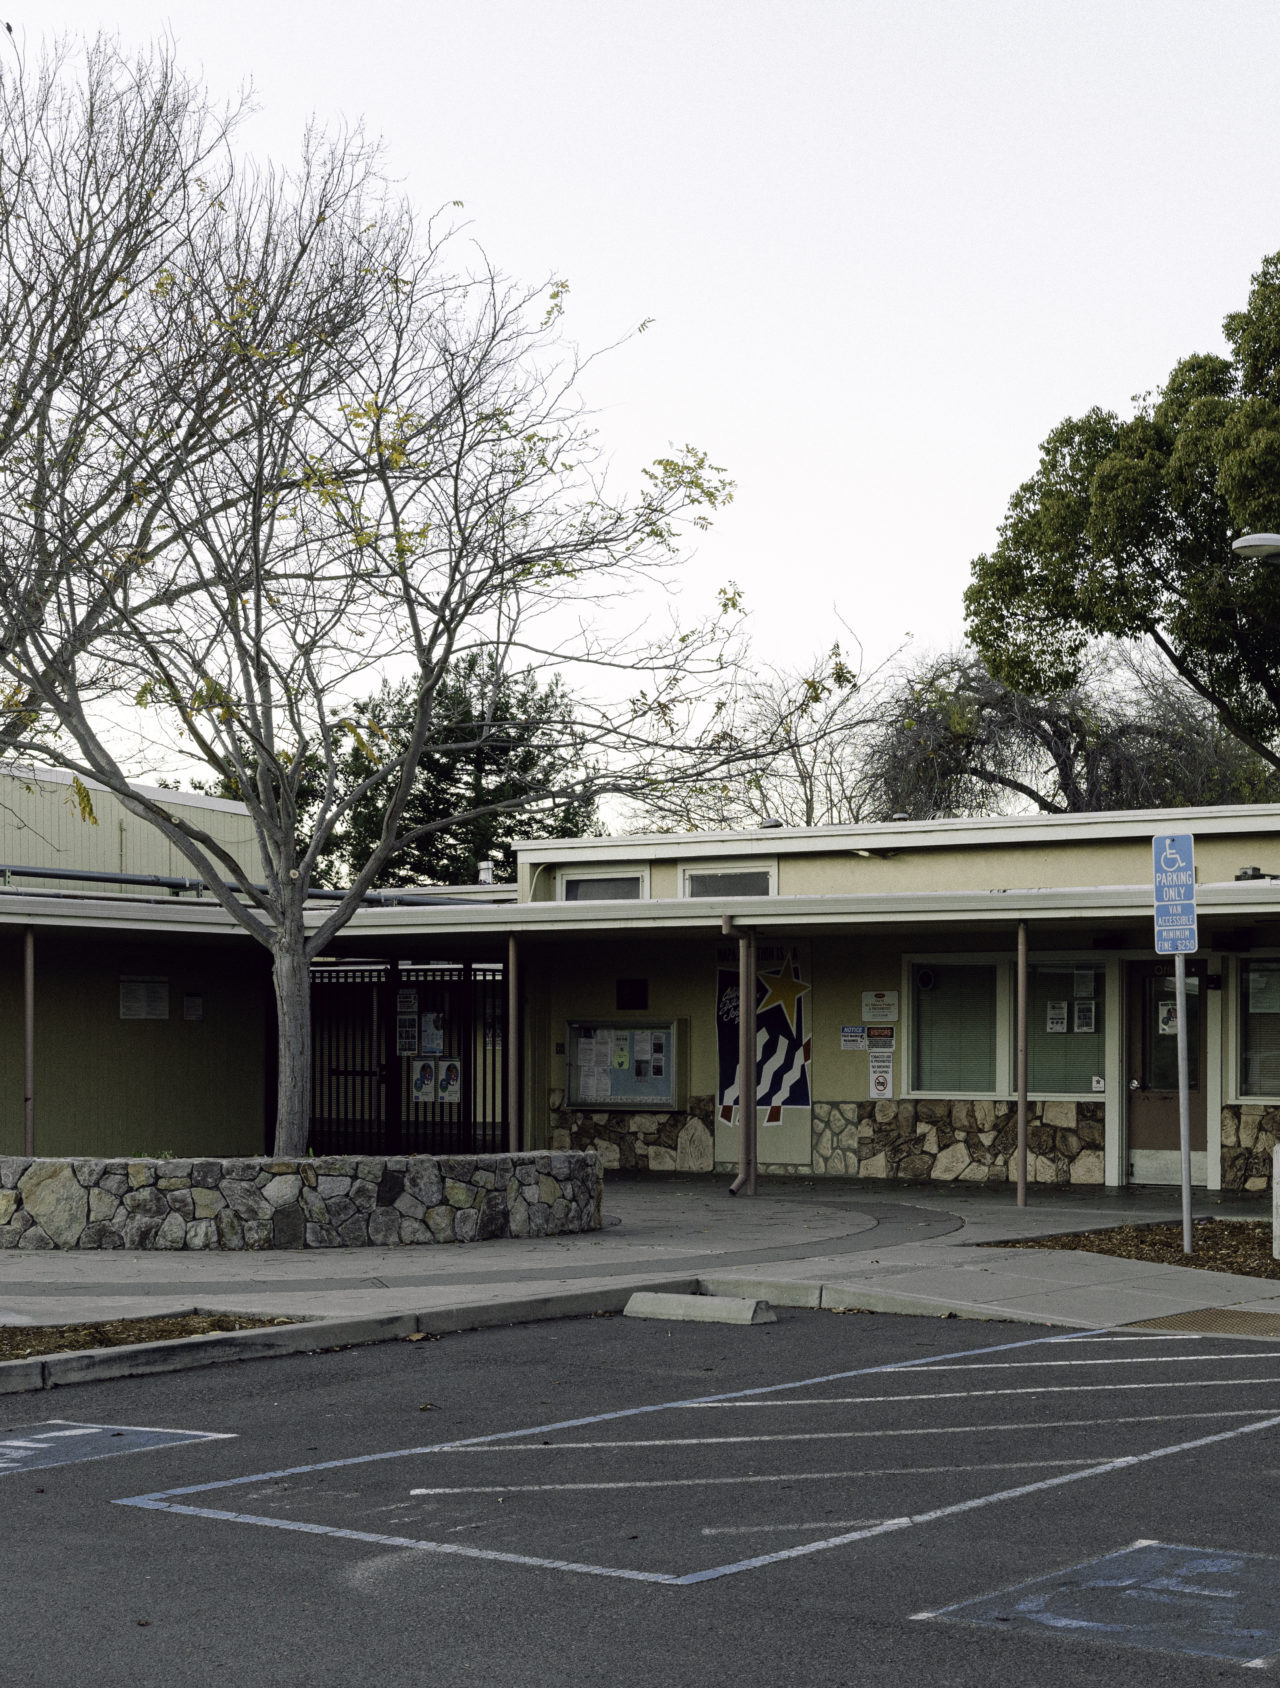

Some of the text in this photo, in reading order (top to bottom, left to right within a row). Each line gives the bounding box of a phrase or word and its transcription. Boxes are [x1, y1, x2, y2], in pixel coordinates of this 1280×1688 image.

[1156, 871, 1192, 887] PARKING
[1163, 886, 1185, 901] ONLY
[1168, 904, 1182, 915] VAN
[1158, 915, 1193, 927] ACCESSIBLE
[1162, 929, 1190, 939] MINIMUM
[1158, 940, 1195, 951] FINE $250
